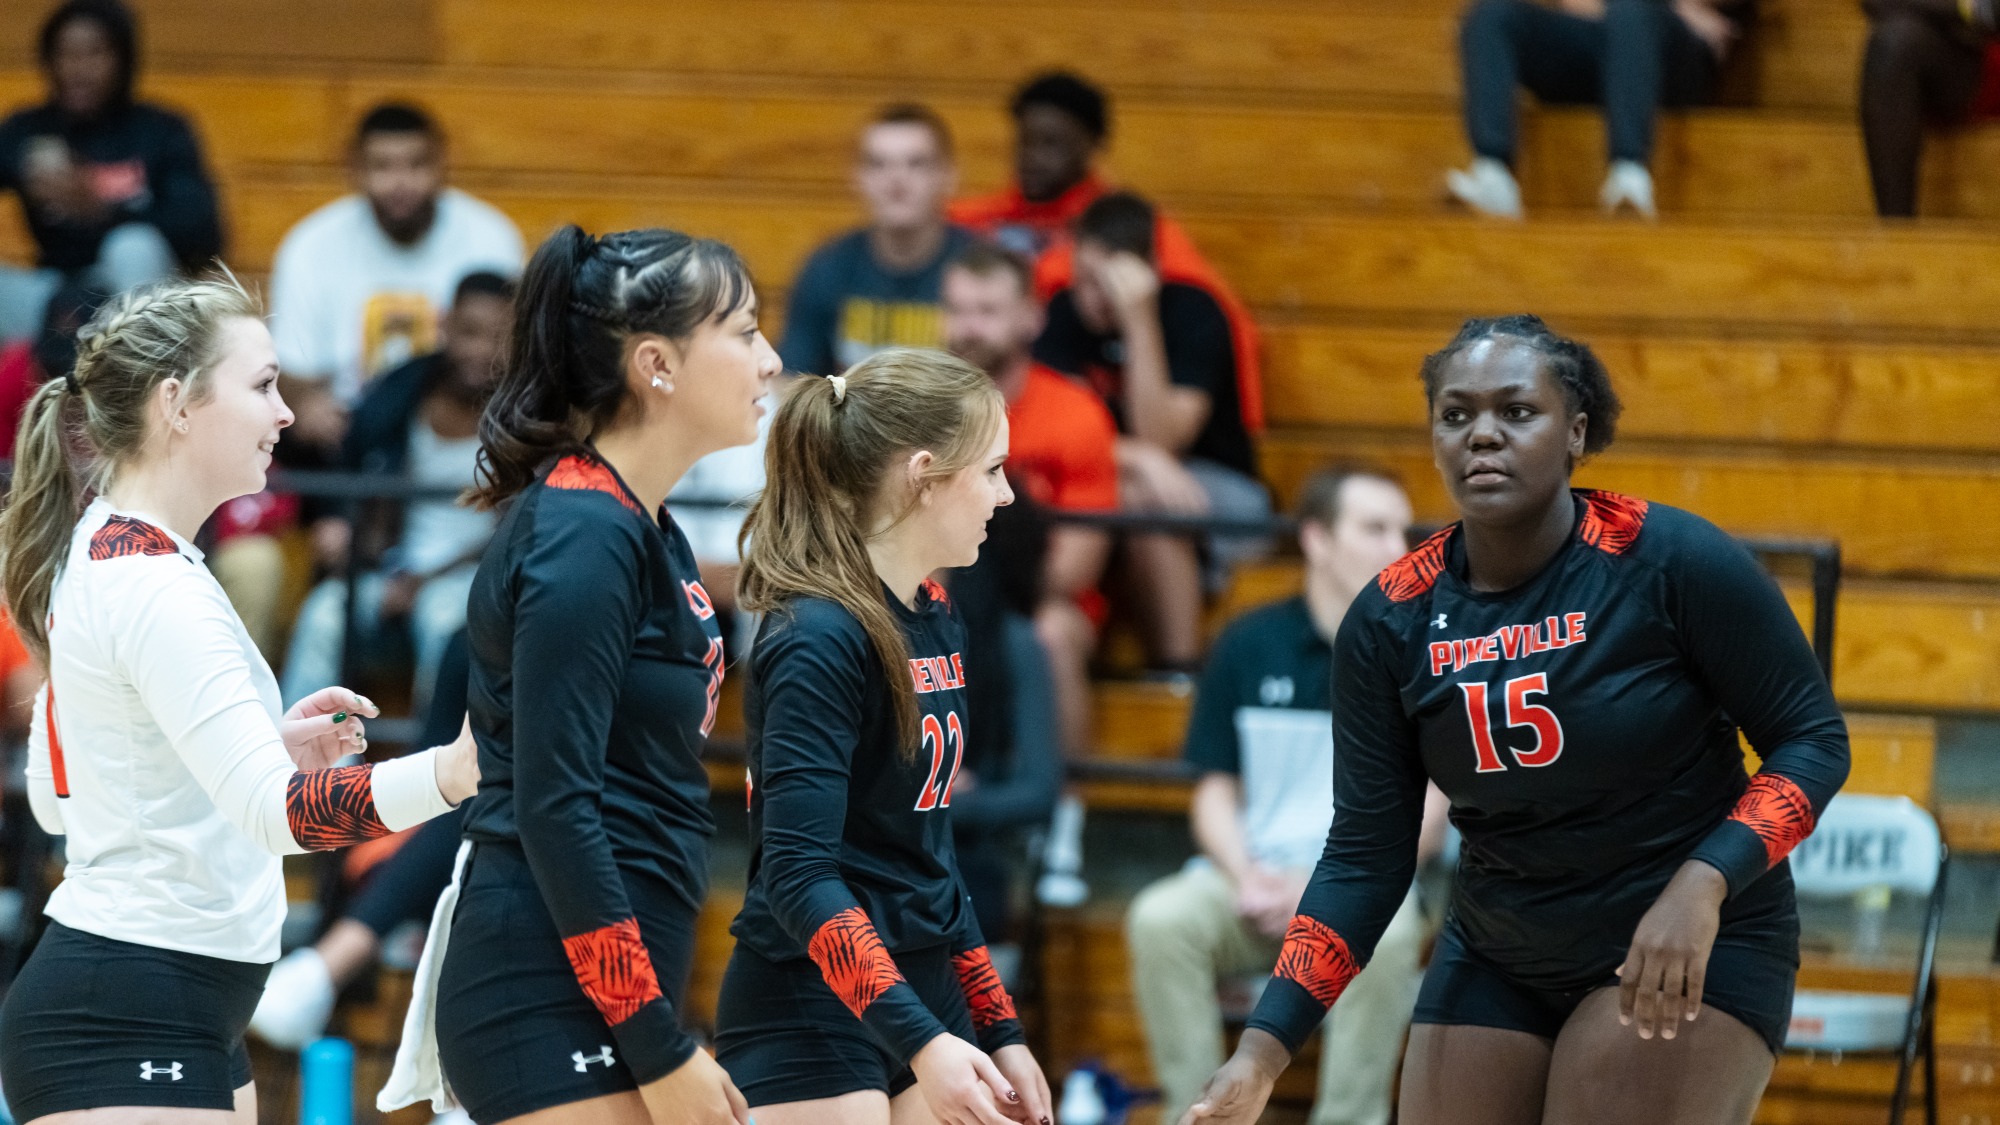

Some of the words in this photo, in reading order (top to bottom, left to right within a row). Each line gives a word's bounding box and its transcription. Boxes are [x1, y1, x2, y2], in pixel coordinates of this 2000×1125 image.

[1429, 611, 1587, 676] PIKEVILLE
[913, 710, 964, 812] 22
[1456, 672, 1565, 773] 15
